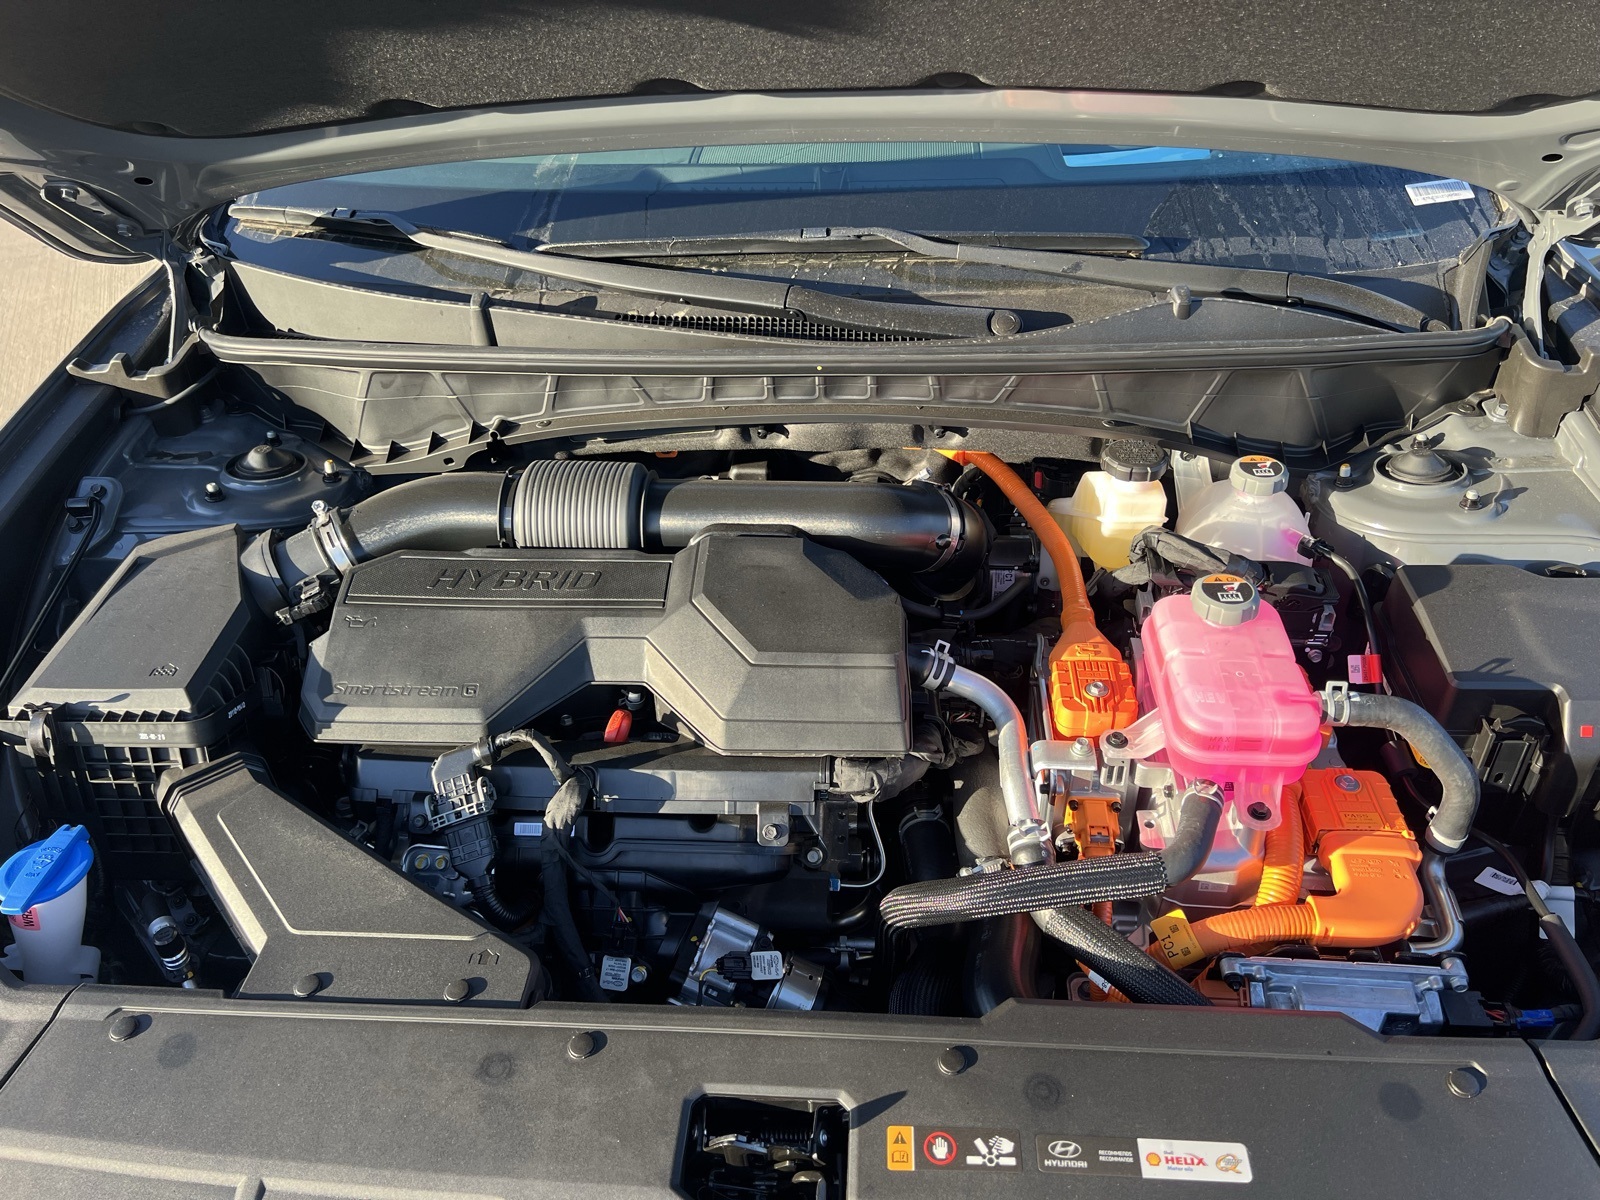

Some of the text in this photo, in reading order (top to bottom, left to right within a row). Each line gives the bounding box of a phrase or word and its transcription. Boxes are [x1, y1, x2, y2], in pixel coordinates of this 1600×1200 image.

[426, 568, 603, 592] HYBRID
[332, 681, 458, 698] Smartstream
[1160, 934, 1179, 959] PC1
[1044, 1158, 1088, 1168] HYUNDAI
[1164, 1155, 1207, 1167] HELIX
